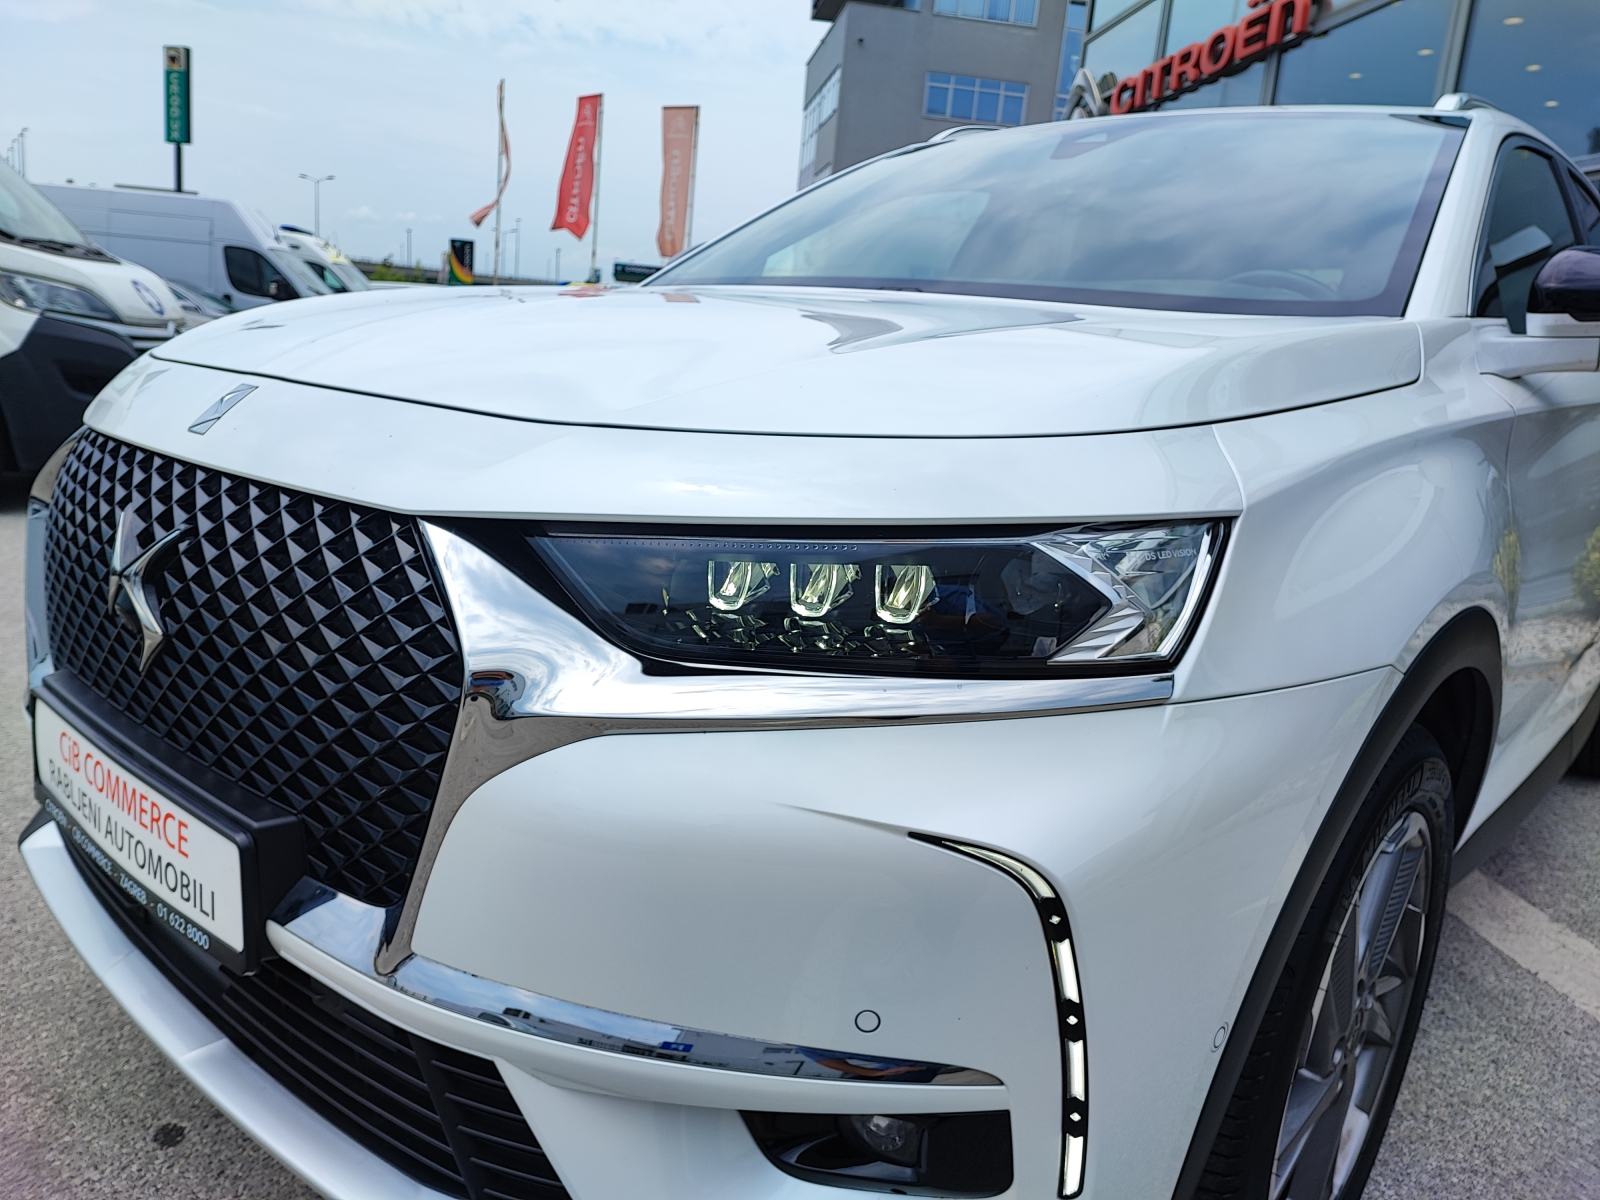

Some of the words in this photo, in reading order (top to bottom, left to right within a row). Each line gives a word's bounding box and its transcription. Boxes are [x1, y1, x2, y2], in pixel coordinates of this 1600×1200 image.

[1145, 552, 1157, 561] DS
[1158, 550, 1172, 560] LED
[1173, 548, 1197, 558] VISION
[48, 757, 102, 834] RABLJENI
[104, 814, 215, 921] AUTOMOBILI
[84, 752, 190, 859] COMMERCE
[169, 911, 186, 935] 622
[186, 922, 210, 951] 8000
